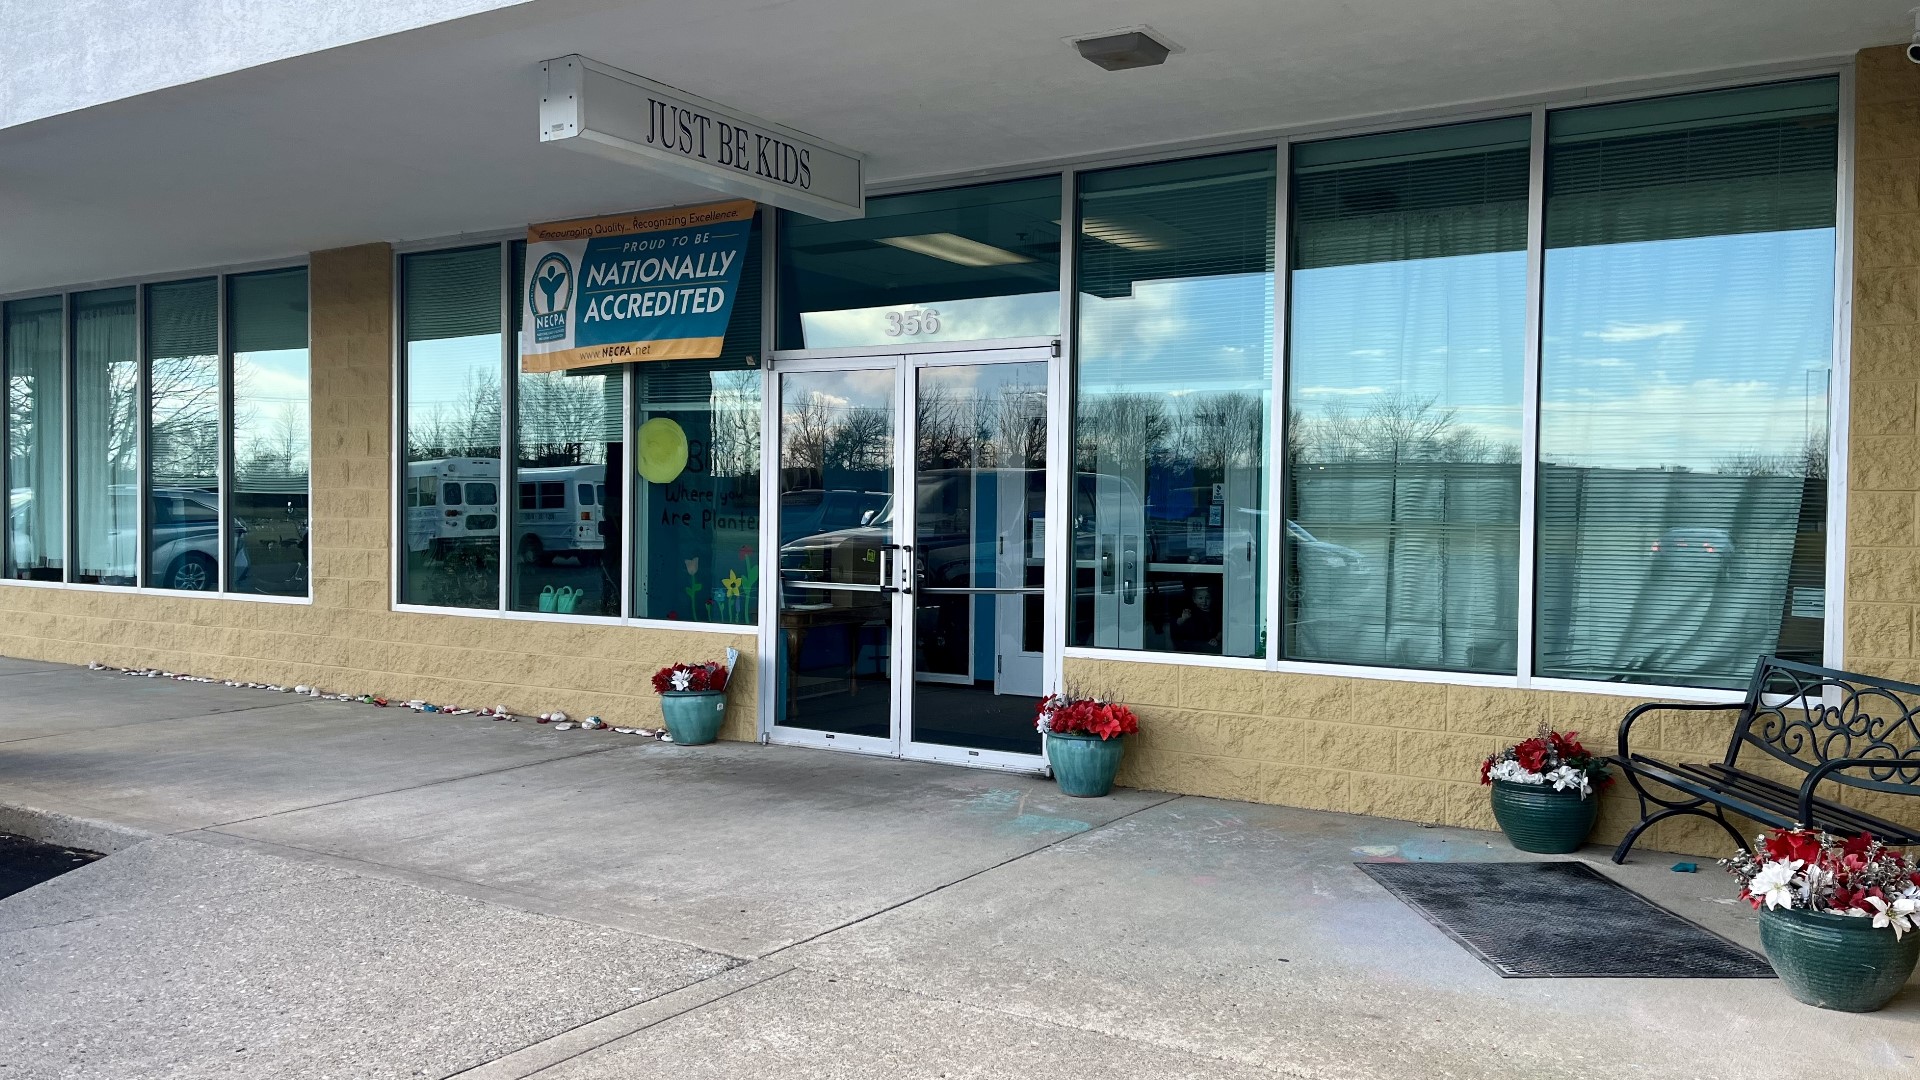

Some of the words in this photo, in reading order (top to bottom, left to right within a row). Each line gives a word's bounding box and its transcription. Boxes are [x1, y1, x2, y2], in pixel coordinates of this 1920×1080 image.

[647, 98, 710, 157] JUST
[717, 120, 750, 171] BE
[755, 133, 811, 190] KIDS
[538, 225, 593, 239] Encouraging
[633, 214, 687, 230] Recognizing
[622, 239, 666, 253] PROUD
[672, 235, 689, 247] TO
[694, 232, 710, 244] BE
[586, 250, 736, 287] NATIONALLY
[584, 287, 725, 323] ACCREDITED
[536, 316, 565, 329] NECPA
[885, 309, 941, 336] 356
[667, 485, 713, 502] Where
[721, 490, 743, 506] you
[662, 509, 691, 526] Are
